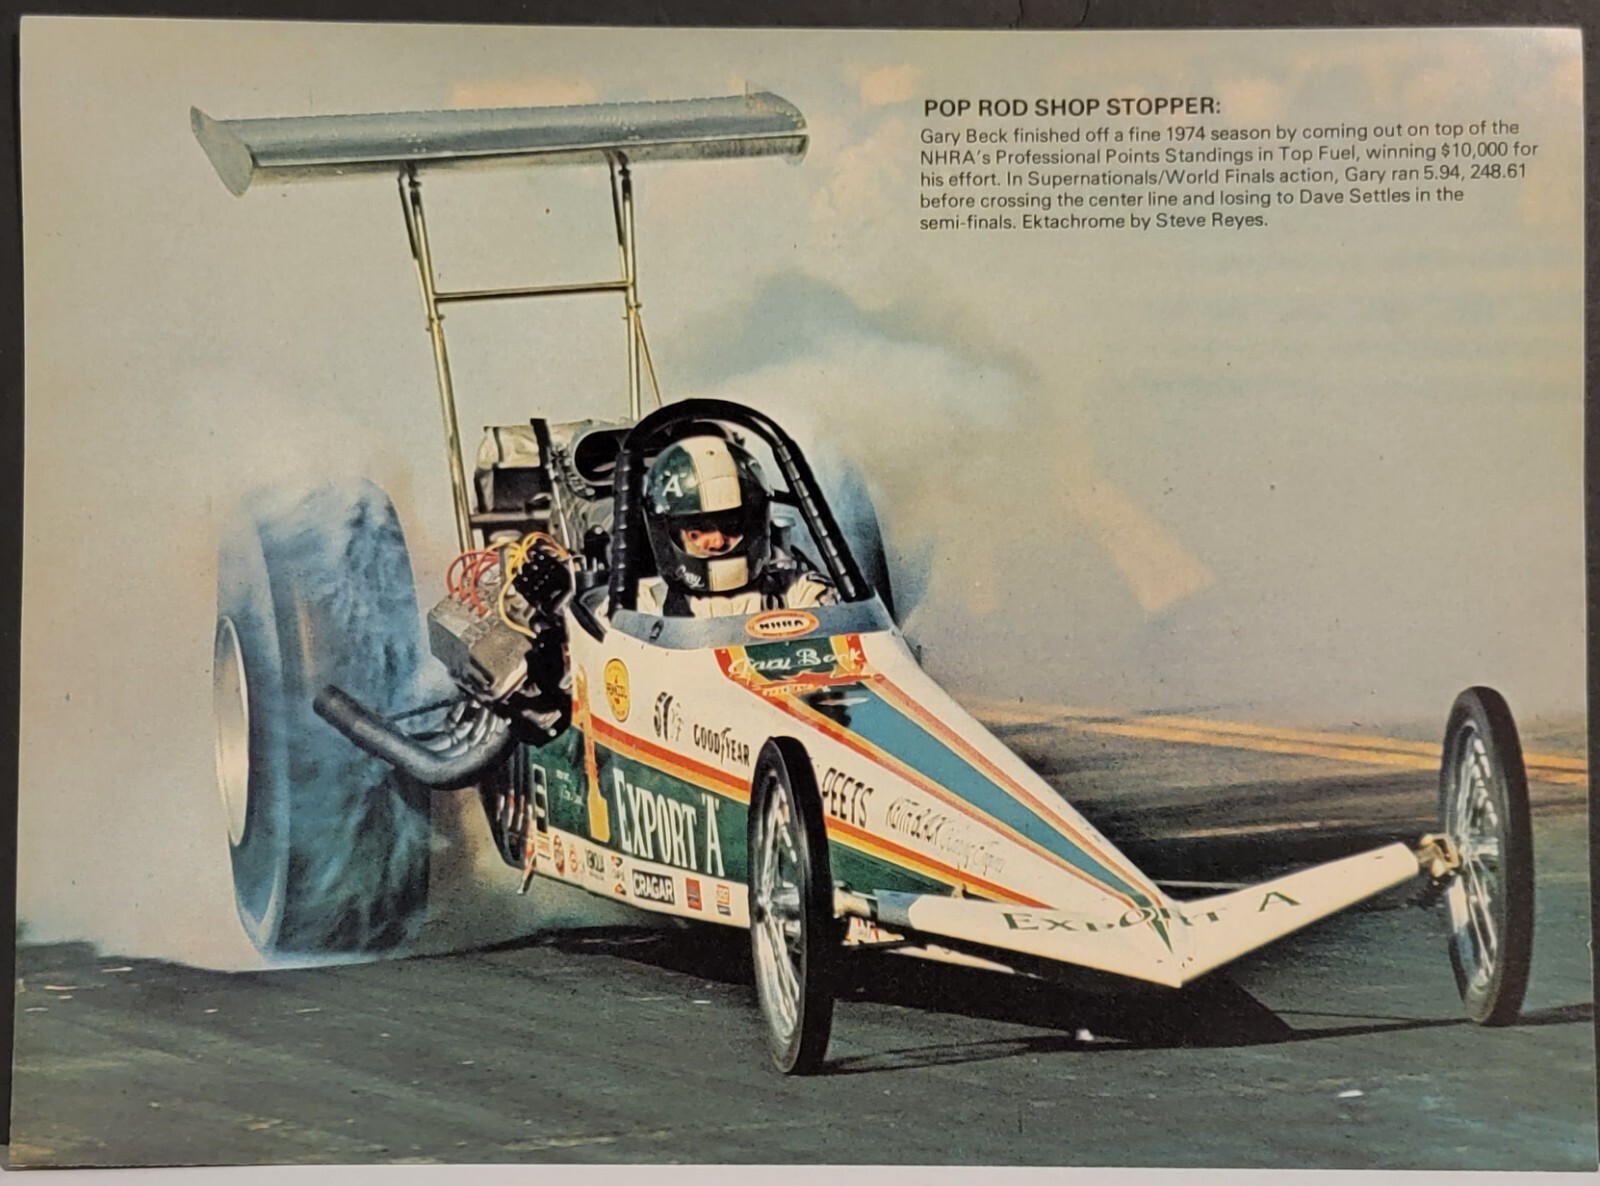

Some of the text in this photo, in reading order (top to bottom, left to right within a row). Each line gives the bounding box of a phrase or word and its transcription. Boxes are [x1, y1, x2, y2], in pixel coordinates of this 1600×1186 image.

[924, 96, 1221, 118] POP ROD SHOP STOPPER:
[920, 119, 1520, 147] Gary Beck finished off a fine 1974 season by coming out on top of the
[920, 140, 1539, 166] NHRA's Professional Points Standings in Top Fuel, winning $10,000 for
[920, 162, 1526, 190] his effort. In Supernationals/World Finals action, Gary ran 5.94, 248.61
[920, 185, 1465, 211] before crossing the center line and losing to Dave Settles in the
[919, 211, 1268, 232] semi-finals. Ektachrome by Steve Reyes.
[692, 722, 750, 768] GOODYEAR
[612, 766, 698, 871] EXPORT
[632, 873, 676, 903] CRAGAR
[1257, 890, 1302, 912] A
